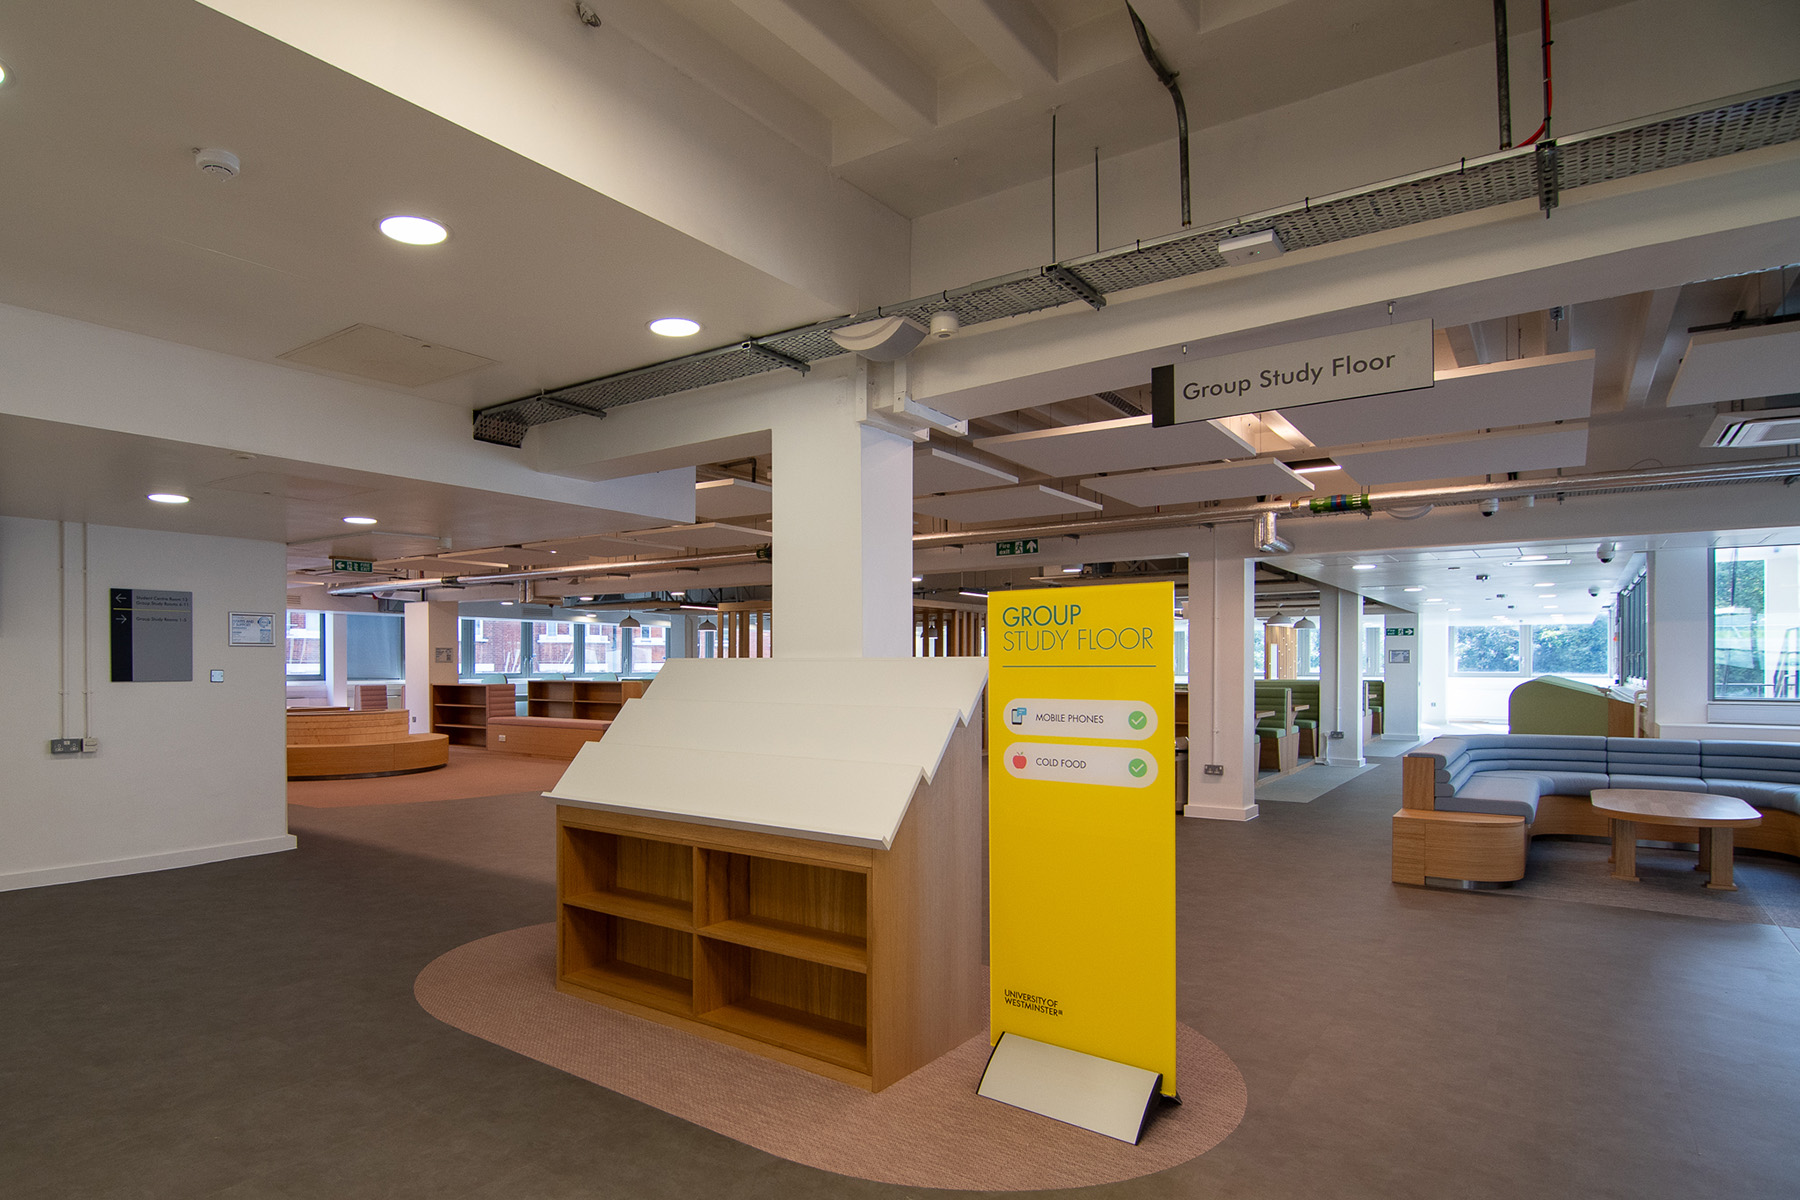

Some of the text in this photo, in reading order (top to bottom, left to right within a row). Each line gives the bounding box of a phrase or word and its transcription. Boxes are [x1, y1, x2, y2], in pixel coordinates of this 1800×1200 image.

[1182, 354, 1396, 400] Group Study Floor
[1002, 604, 1082, 627] GROUP
[1003, 627, 1154, 652] STUDY FLOOR
[1035, 713, 1104, 724] MOBILE PHONES
[1035, 757, 1087, 769] COLD FOOD
[1004, 989, 1058, 1008] UNIVERSITY OF
